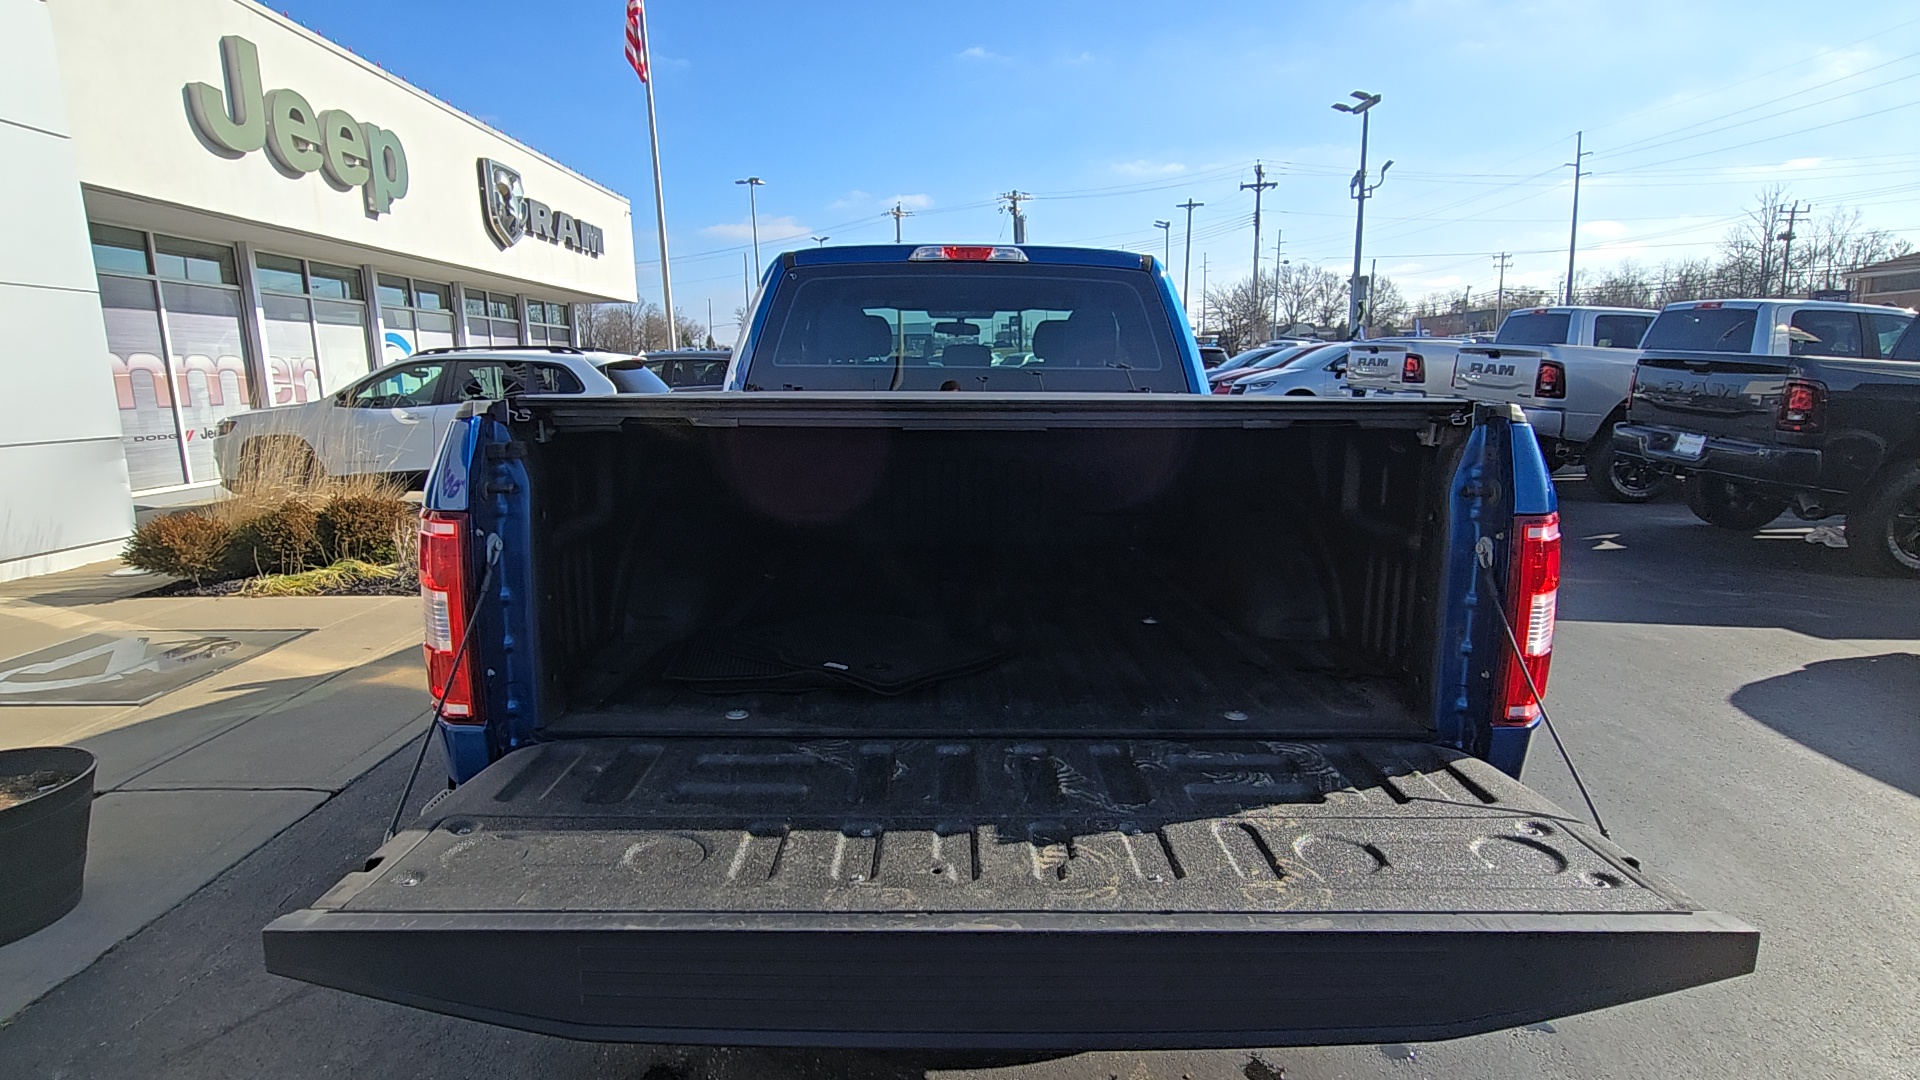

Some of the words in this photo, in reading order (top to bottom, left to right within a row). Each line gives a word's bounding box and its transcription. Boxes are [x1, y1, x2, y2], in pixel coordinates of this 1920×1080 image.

[182, 35, 409, 220] Jeep
[525, 198, 604, 259] RAM
[1357, 357, 1389, 367] RAM
[1470, 362, 1516, 376] RAM
[1661, 379, 1741, 399] RAM
[133, 433, 178, 442] DODG
